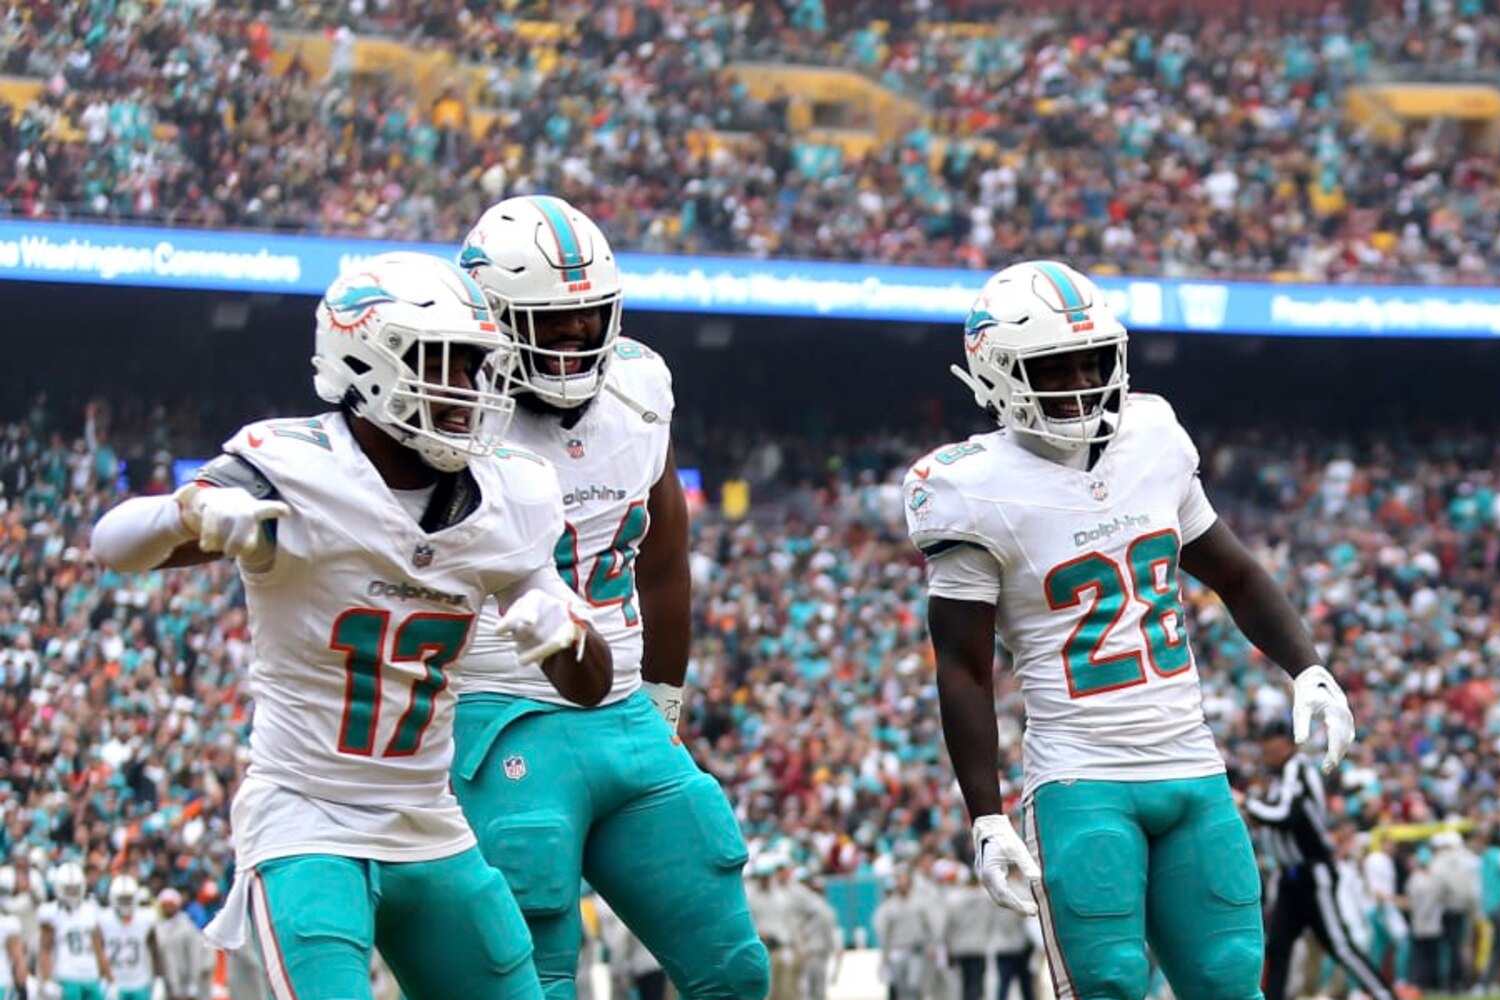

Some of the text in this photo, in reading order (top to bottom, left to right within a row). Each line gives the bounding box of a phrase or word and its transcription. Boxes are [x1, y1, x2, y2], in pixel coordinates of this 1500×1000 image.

[21, 235, 152, 279] Washington
[154, 241, 300, 282] Commanders
[562, 485, 627, 506] olphins
[553, 499, 647, 628] 4
[1044, 527, 1192, 700] 28
[329, 608, 475, 757] 17
